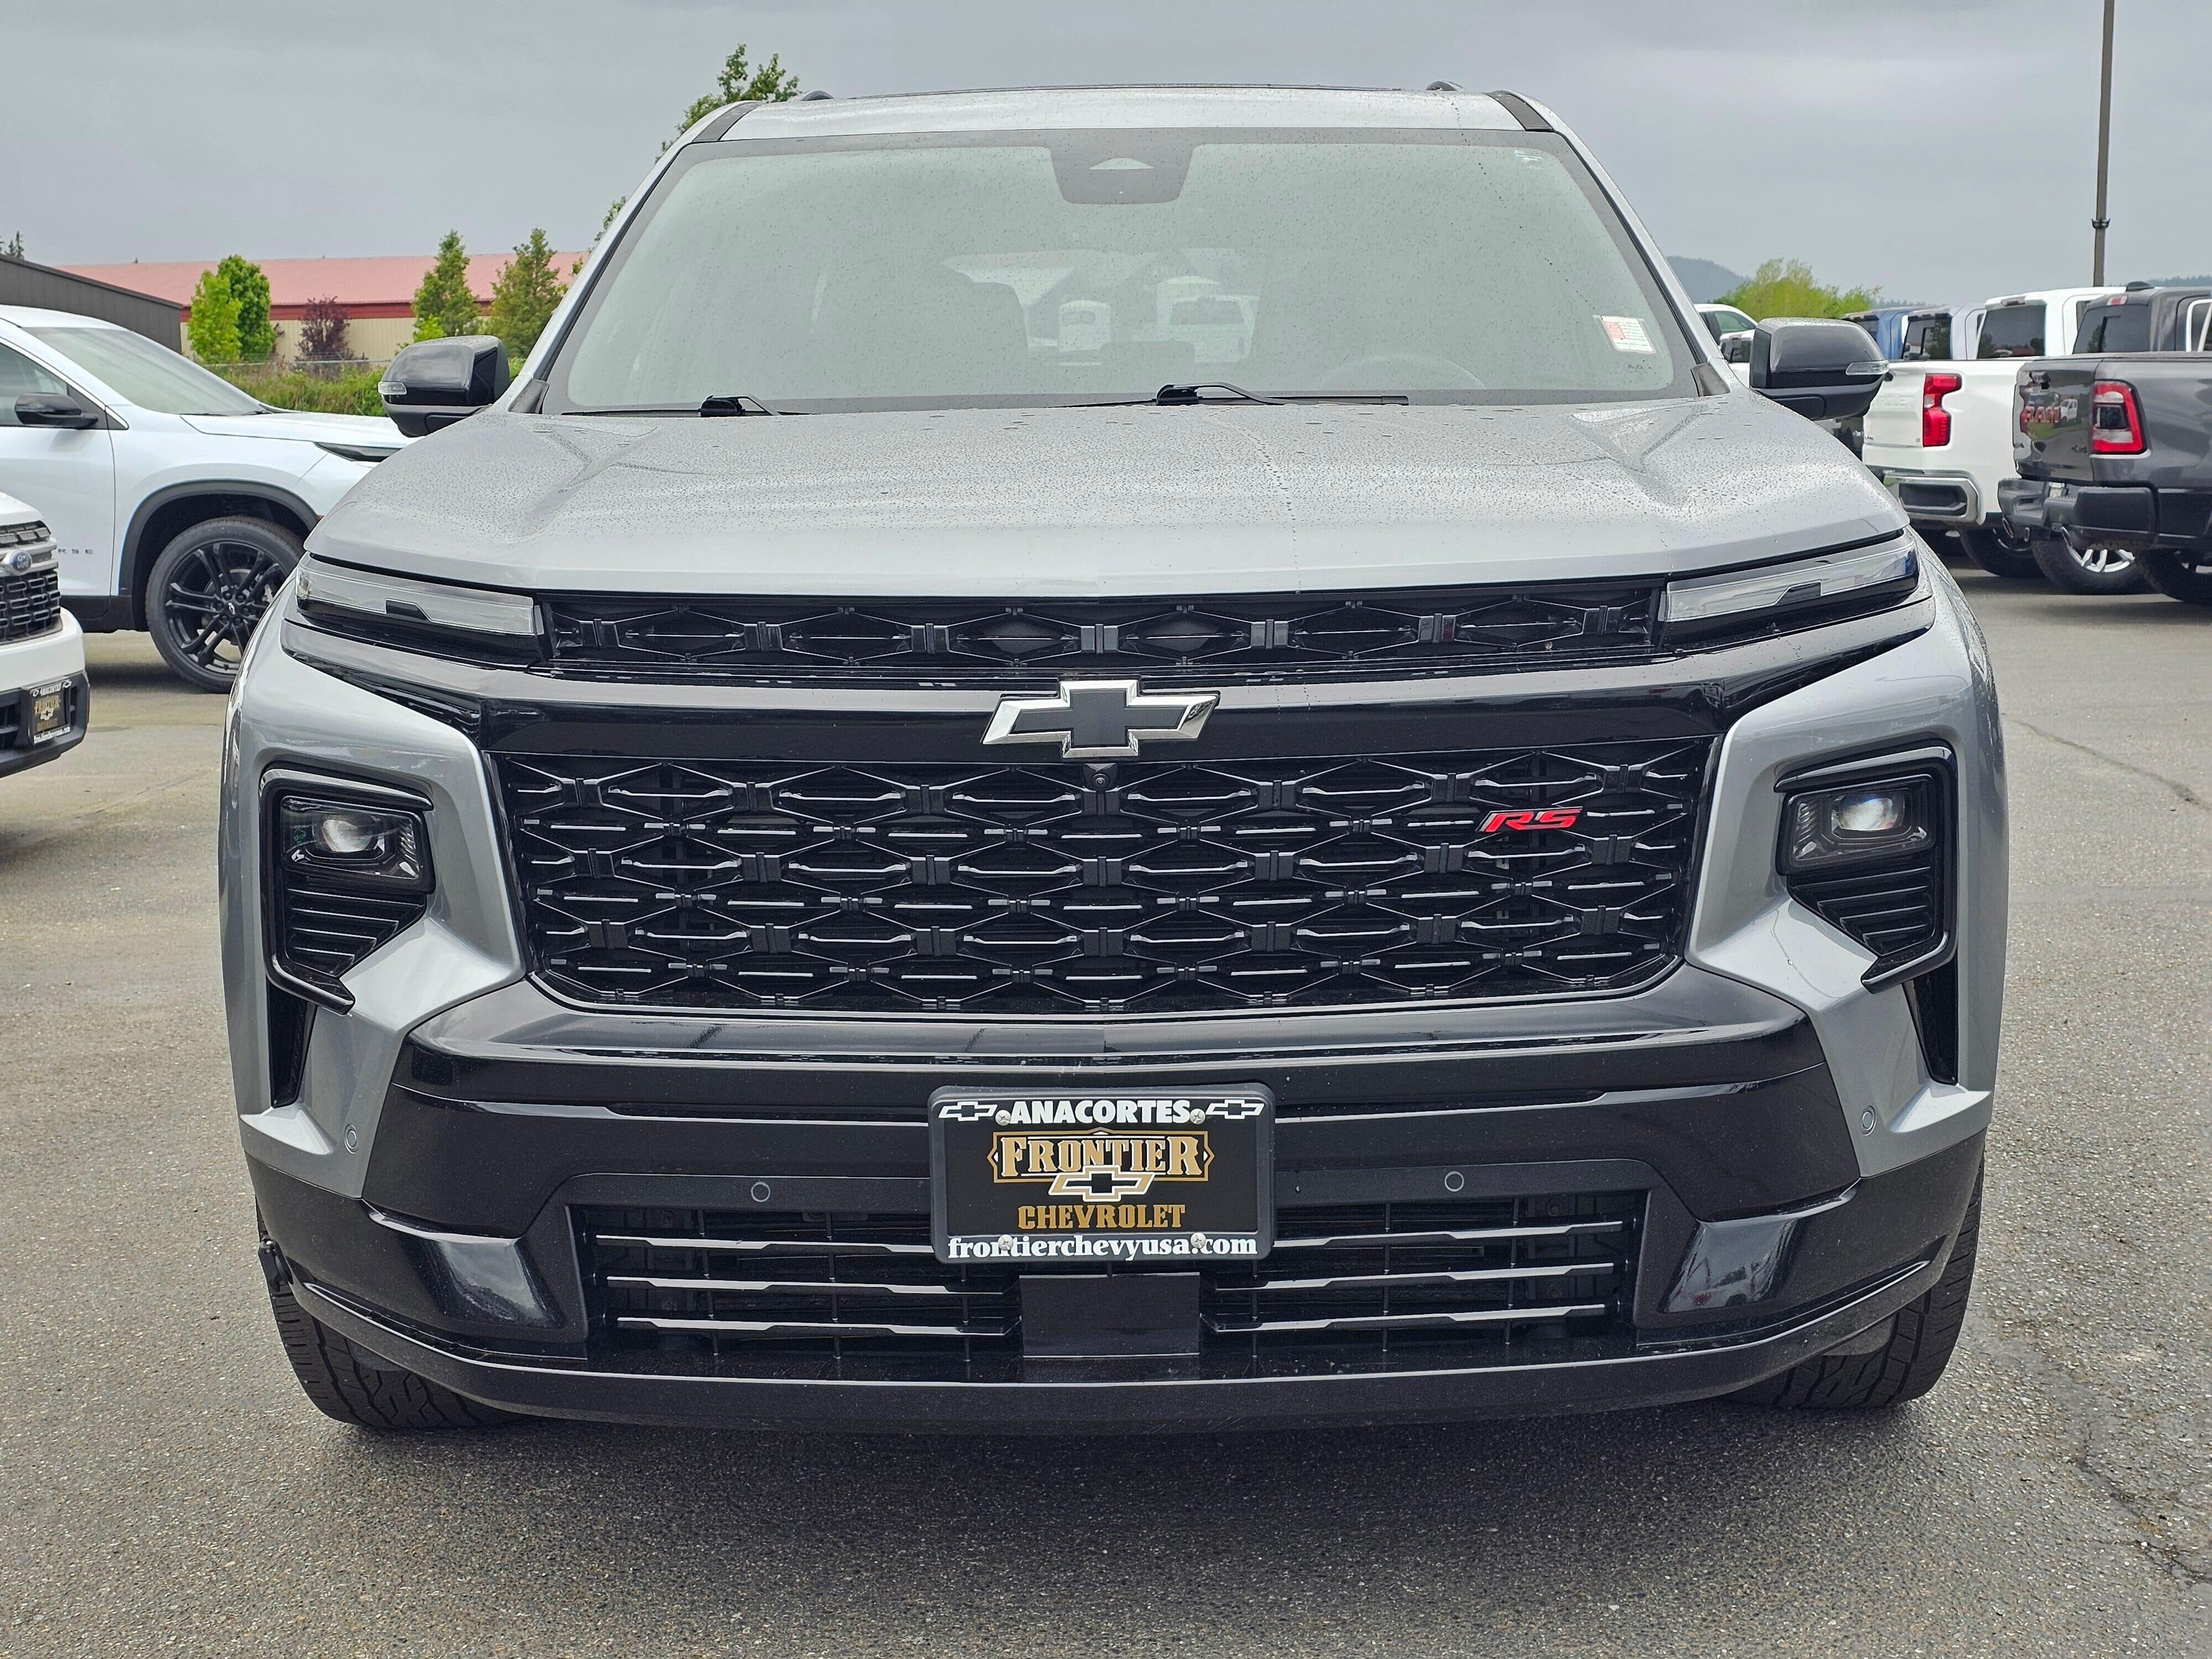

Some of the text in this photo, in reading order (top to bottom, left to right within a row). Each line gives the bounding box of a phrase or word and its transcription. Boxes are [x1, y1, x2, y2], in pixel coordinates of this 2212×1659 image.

[2023, 406, 2060, 423] RAM
[1477, 807, 1583, 832] RS
[1010, 1100, 1192, 1124] ANACORTES
[1000, 1136, 1203, 1177] FRONTIER
[1018, 1204, 1186, 1230] CHEVROLET
[948, 1235, 1258, 1261] frontierchevyusa.com
